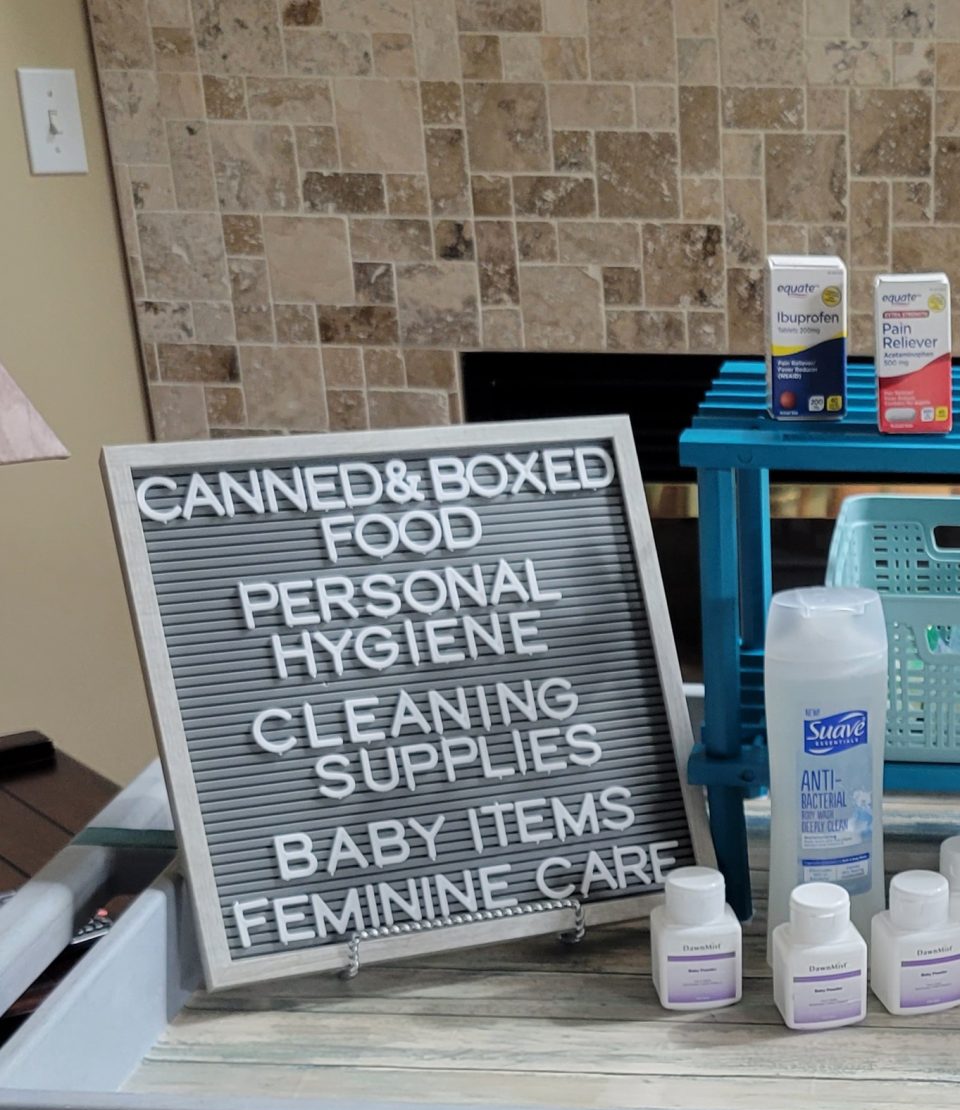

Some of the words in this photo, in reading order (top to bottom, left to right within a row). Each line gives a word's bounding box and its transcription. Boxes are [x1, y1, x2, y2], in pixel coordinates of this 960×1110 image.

[777, 283, 816, 297] equate
[882, 293, 917, 303] equate
[777, 311, 840, 326] Ibuprofen
[882, 322, 912, 335] Pain
[883, 336, 938, 349] Reliever
[321, 506, 483, 564] FOOD
[238, 558, 562, 630] PERSONAL
[272, 610, 548, 679] HYGIENE
[252, 677, 579, 756] CLEANING
[806, 718, 866, 741] Suave
[314, 723, 602, 800] SUPPLIES
[801, 769, 843, 792] ANTI-
[801, 791, 847, 810] BACTERIAL
[274, 815, 446, 881] BABY
[468, 786, 636, 854] ITEMS
[233, 864, 518, 949] FEMININE
[536, 841, 680, 900] CARE
